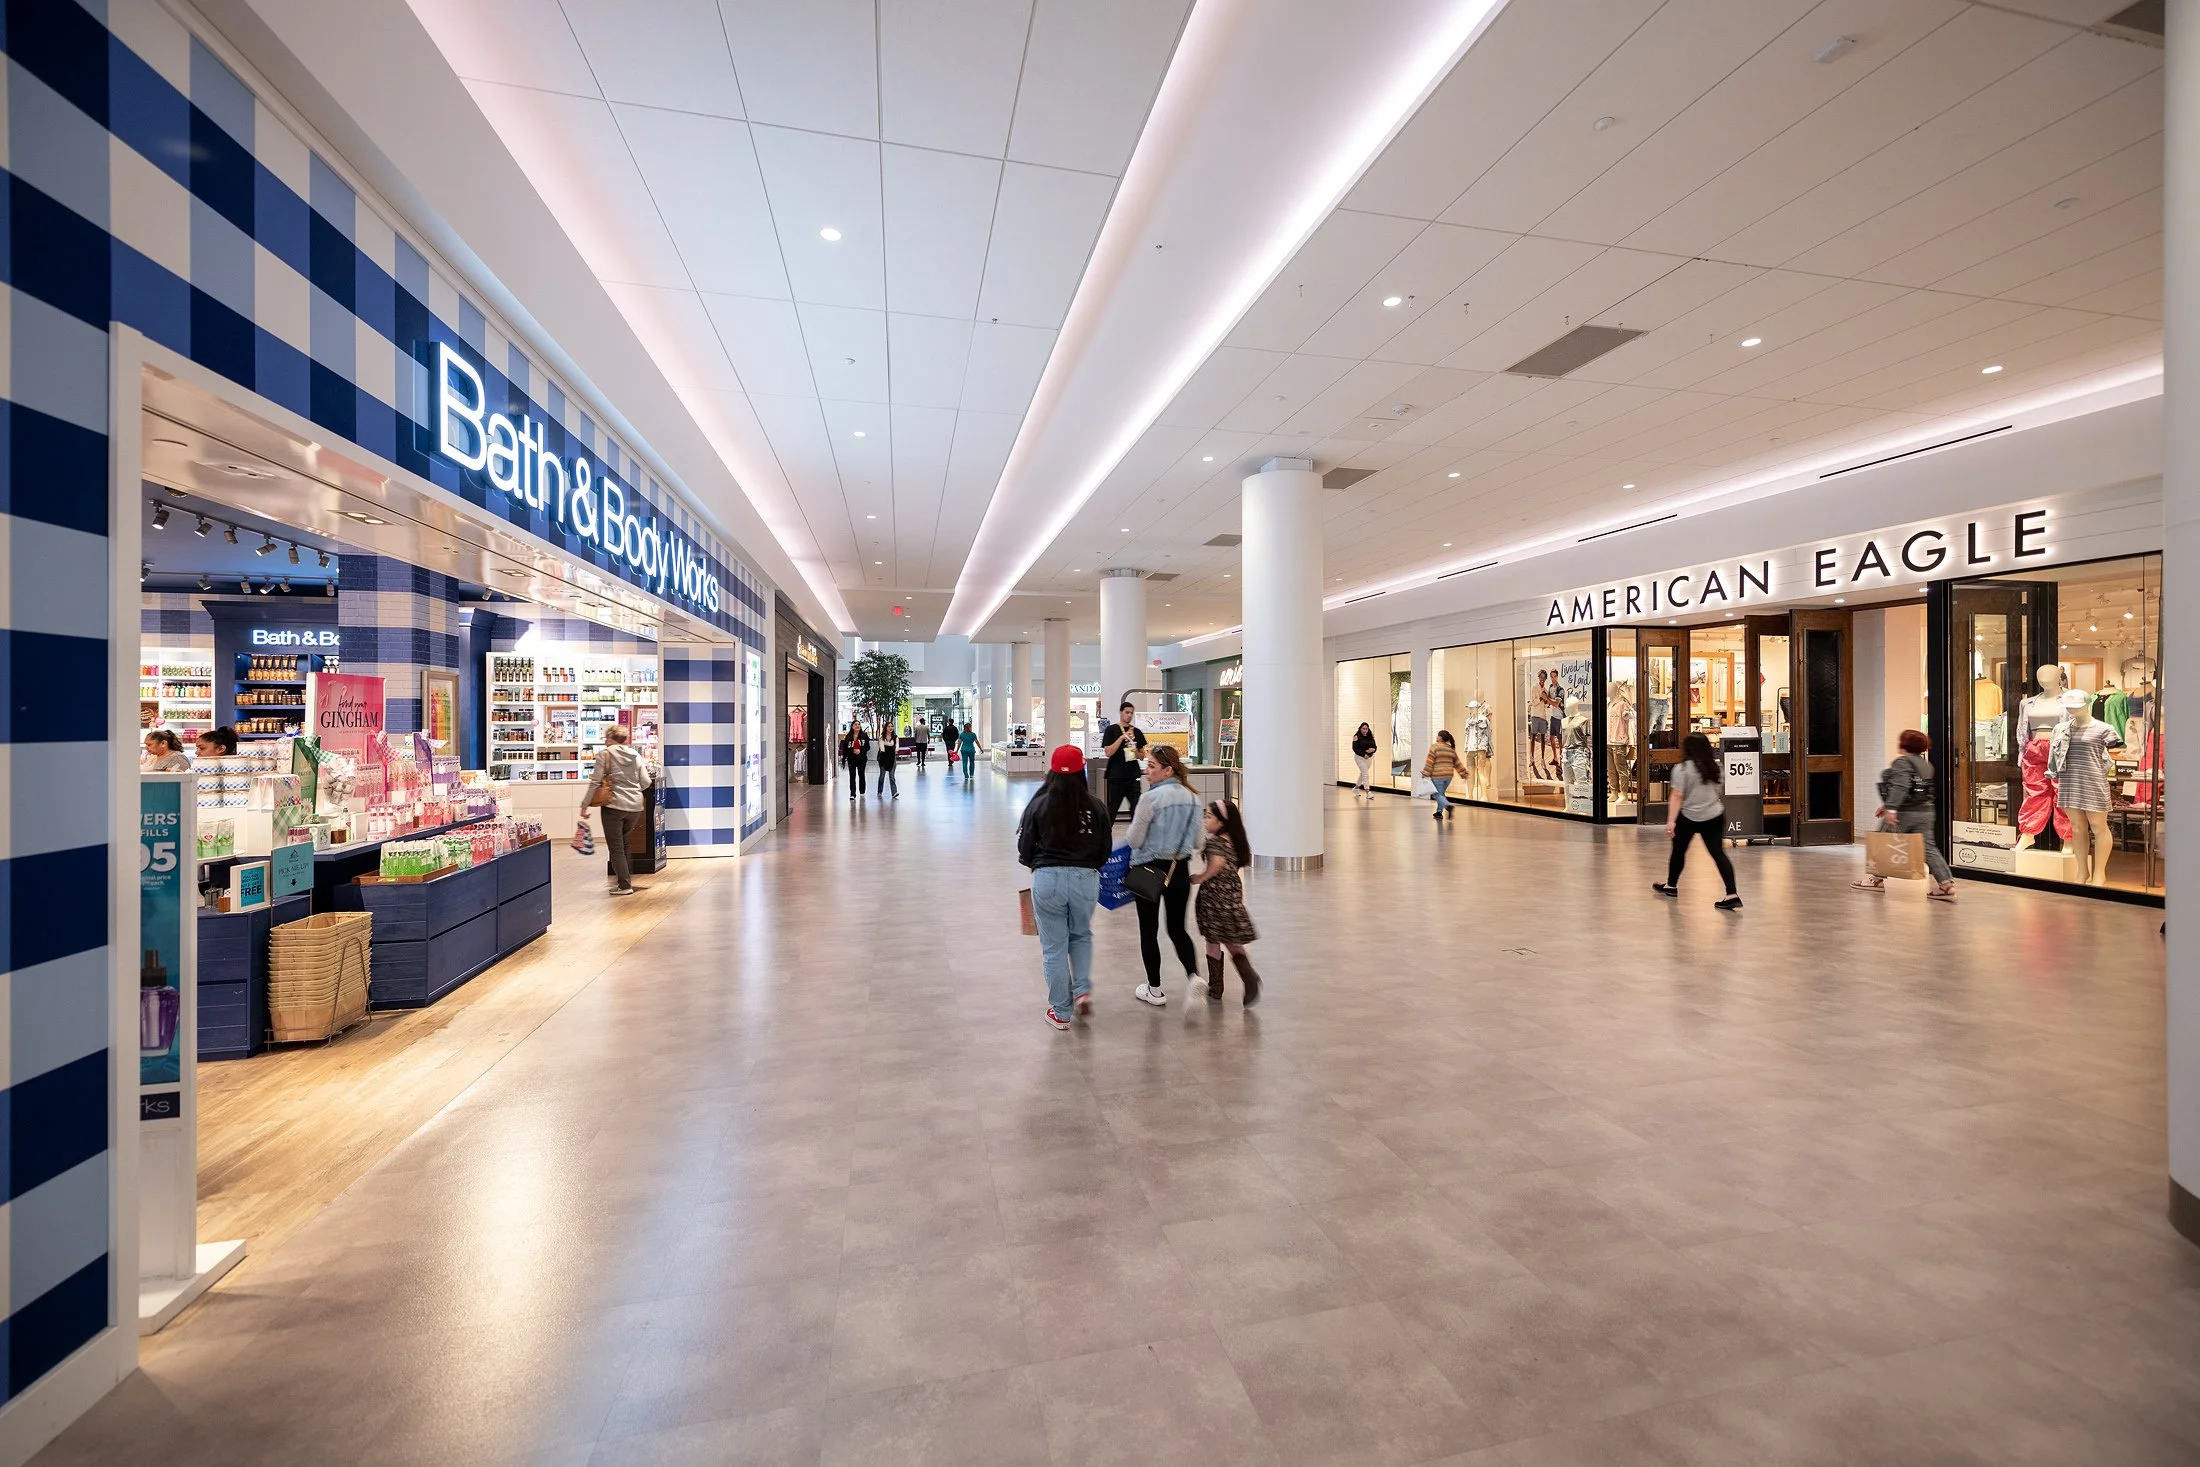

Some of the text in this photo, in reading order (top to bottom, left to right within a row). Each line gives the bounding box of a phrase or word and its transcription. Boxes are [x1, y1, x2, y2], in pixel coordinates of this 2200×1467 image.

[439, 341, 719, 613] Bath & Body Works
[1546, 509, 2047, 627] AMERICAN EAGLE
[252, 629, 301, 645] Bath
[301, 630, 319, 646] &
[1573, 673, 1591, 689] Laid
[320, 710, 379, 729] GINGHAM
[1729, 763, 1753, 776] 50%
[141, 812, 178, 826] ERS
[1728, 821, 1741, 832] AE
[278, 866, 292, 876] PICK
[241, 884, 262, 897] FREE
